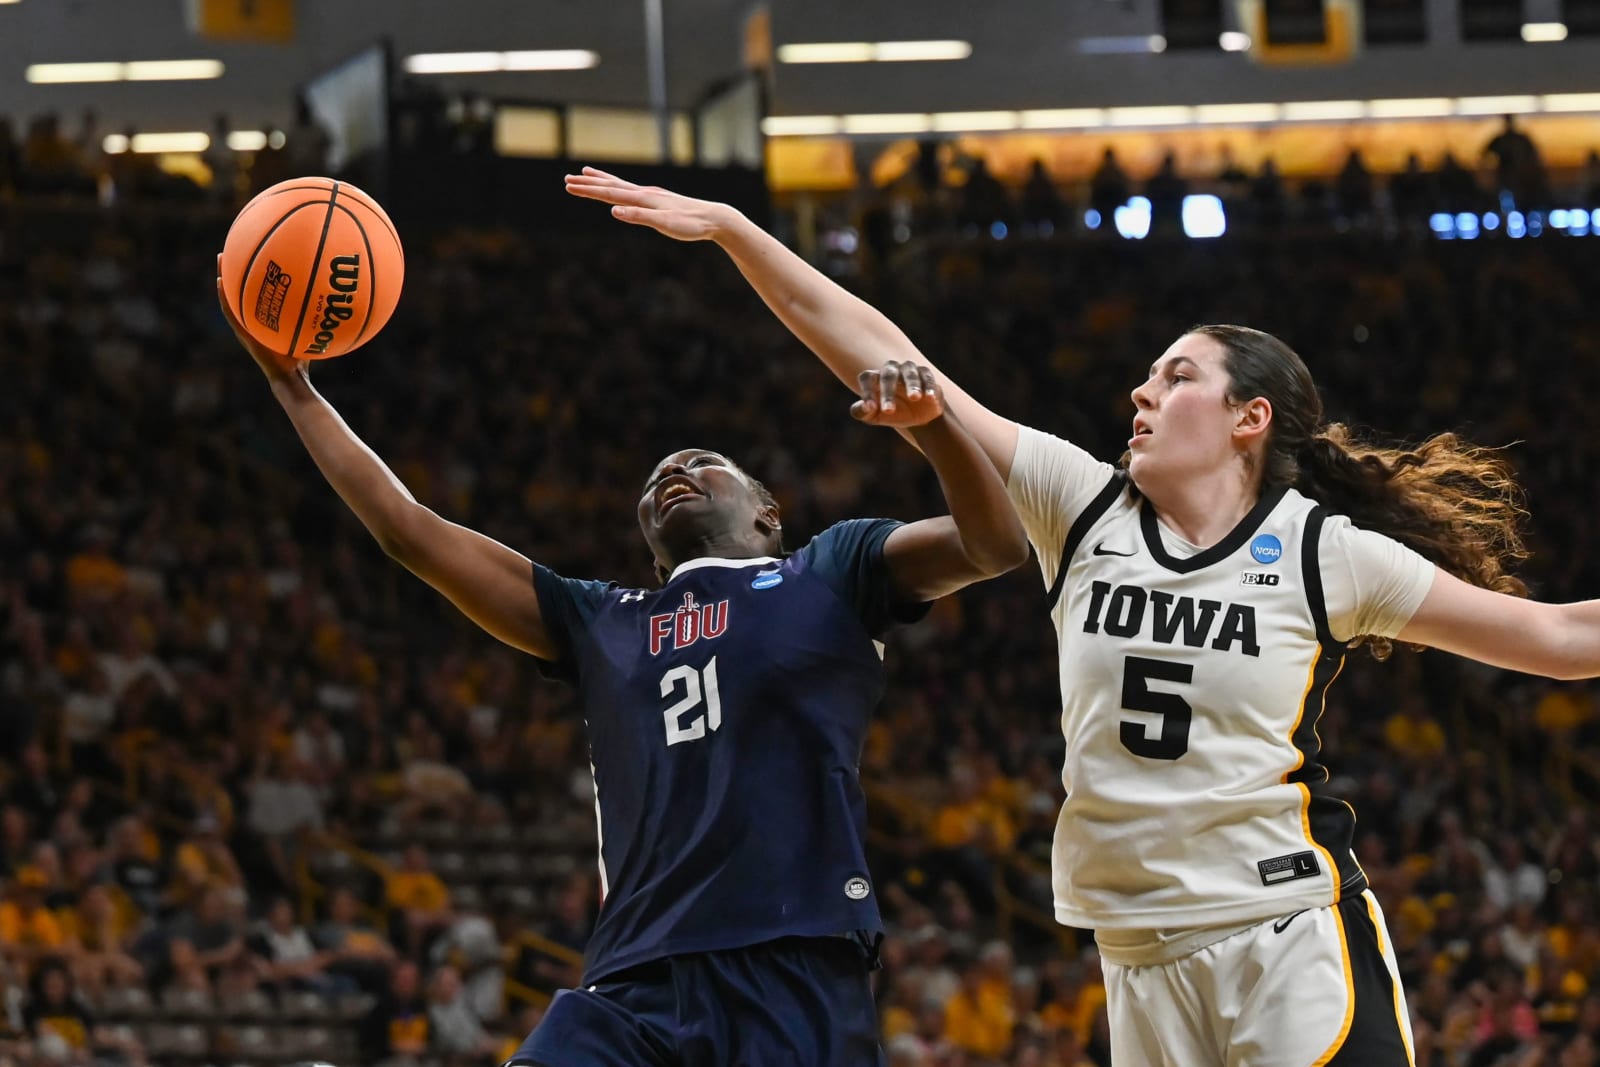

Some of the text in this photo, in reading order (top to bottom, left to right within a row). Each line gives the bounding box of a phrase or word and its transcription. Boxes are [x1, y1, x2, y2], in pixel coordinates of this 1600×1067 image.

[269, 282, 287, 318] MARCH
[303, 254, 360, 354] Wilson
[1254, 546, 1280, 557] NCAA
[650, 598, 729, 656] FDU
[1083, 580, 1261, 657] IOWA
[659, 655, 722, 747] 21
[1119, 655, 1195, 761] 5
[1300, 859, 1310, 870] L
